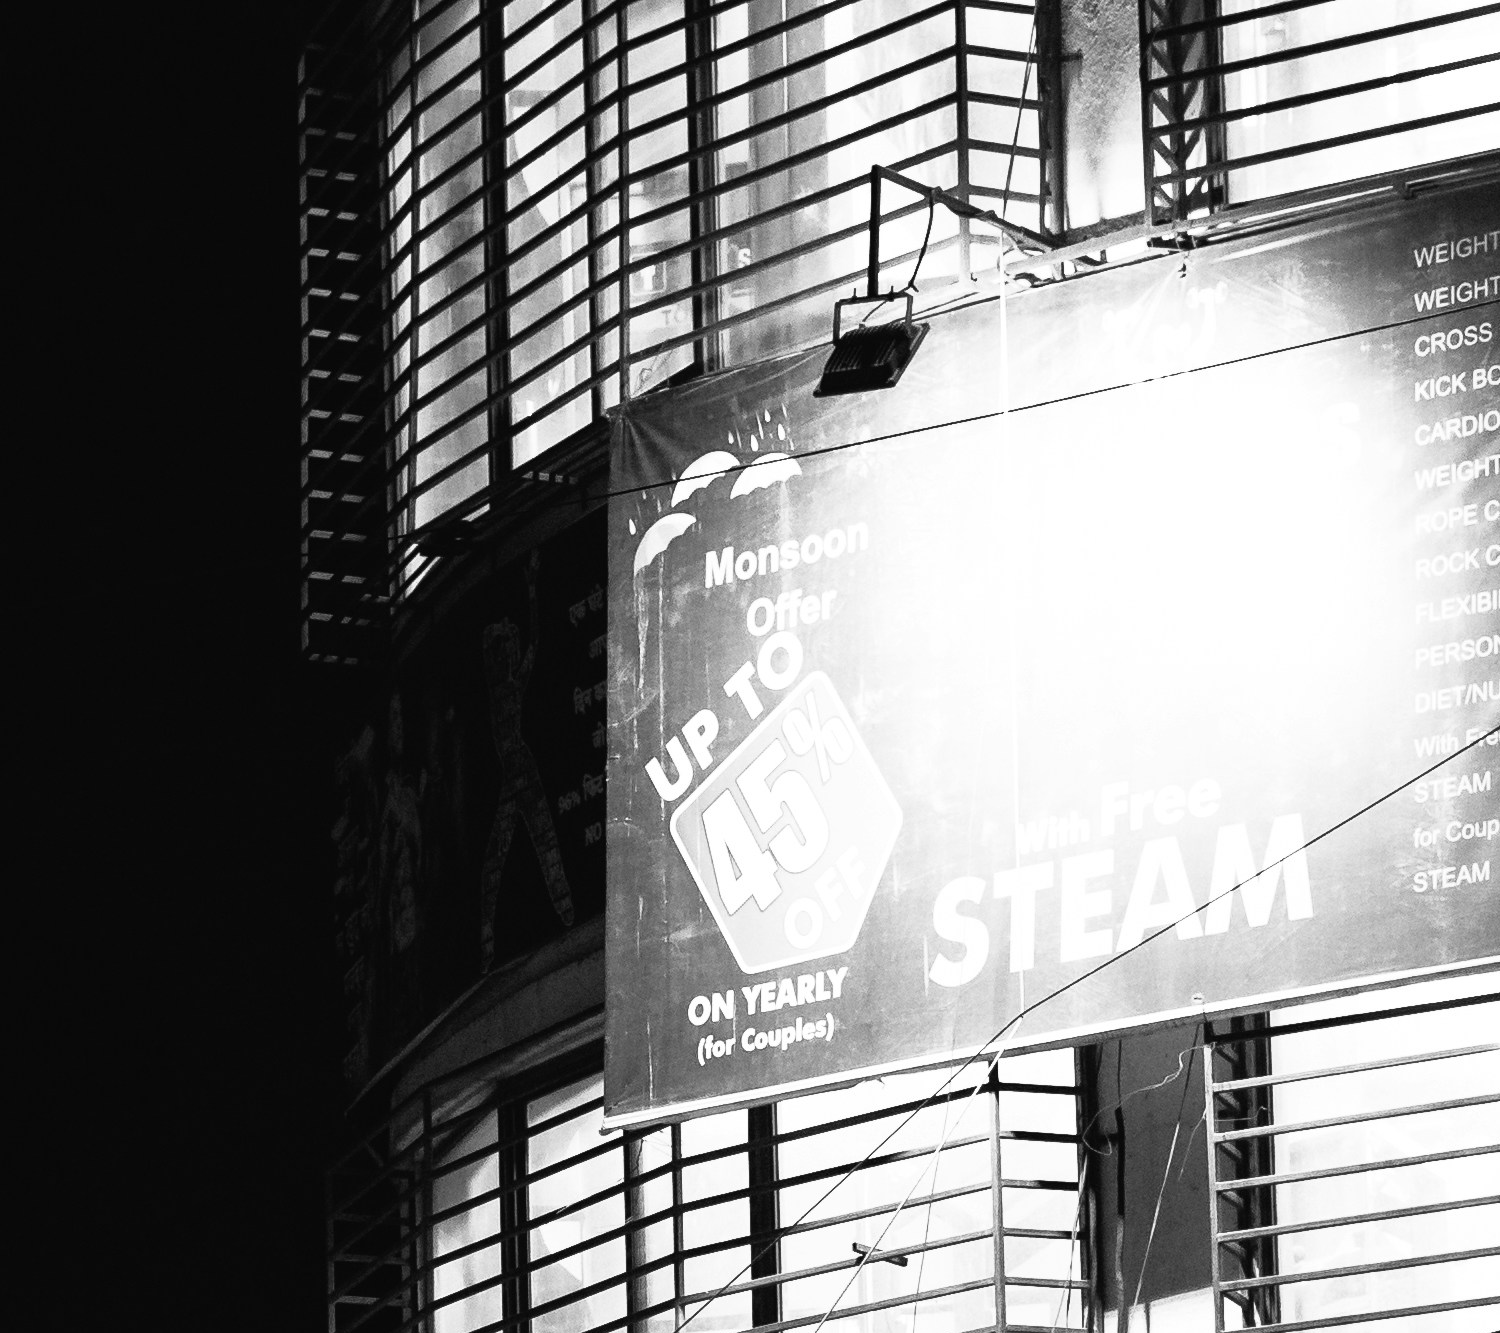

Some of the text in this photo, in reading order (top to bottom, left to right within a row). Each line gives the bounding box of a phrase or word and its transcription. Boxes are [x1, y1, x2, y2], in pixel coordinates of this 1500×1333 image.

[1414, 323, 1493, 357] CROSS
[1414, 370, 1466, 402] KICK
[1415, 504, 1478, 536] ROPE
[704, 521, 869, 588] Monsoon
[1415, 547, 1480, 581] ROCK
[746, 588, 838, 637] Offer
[643, 631, 804, 802] UP TO
[1414, 733, 1459, 759] With
[701, 690, 856, 917] 45%
[1100, 776, 1223, 838] Free
[1414, 771, 1492, 804] STEAM
[1412, 826, 1441, 848] for
[783, 845, 872, 951] OFF
[927, 812, 1314, 988] STEAM
[1412, 860, 1491, 893] STEAM
[687, 966, 849, 1027] ON YEARLY
[697, 1011, 836, 1066] (for Couples)
